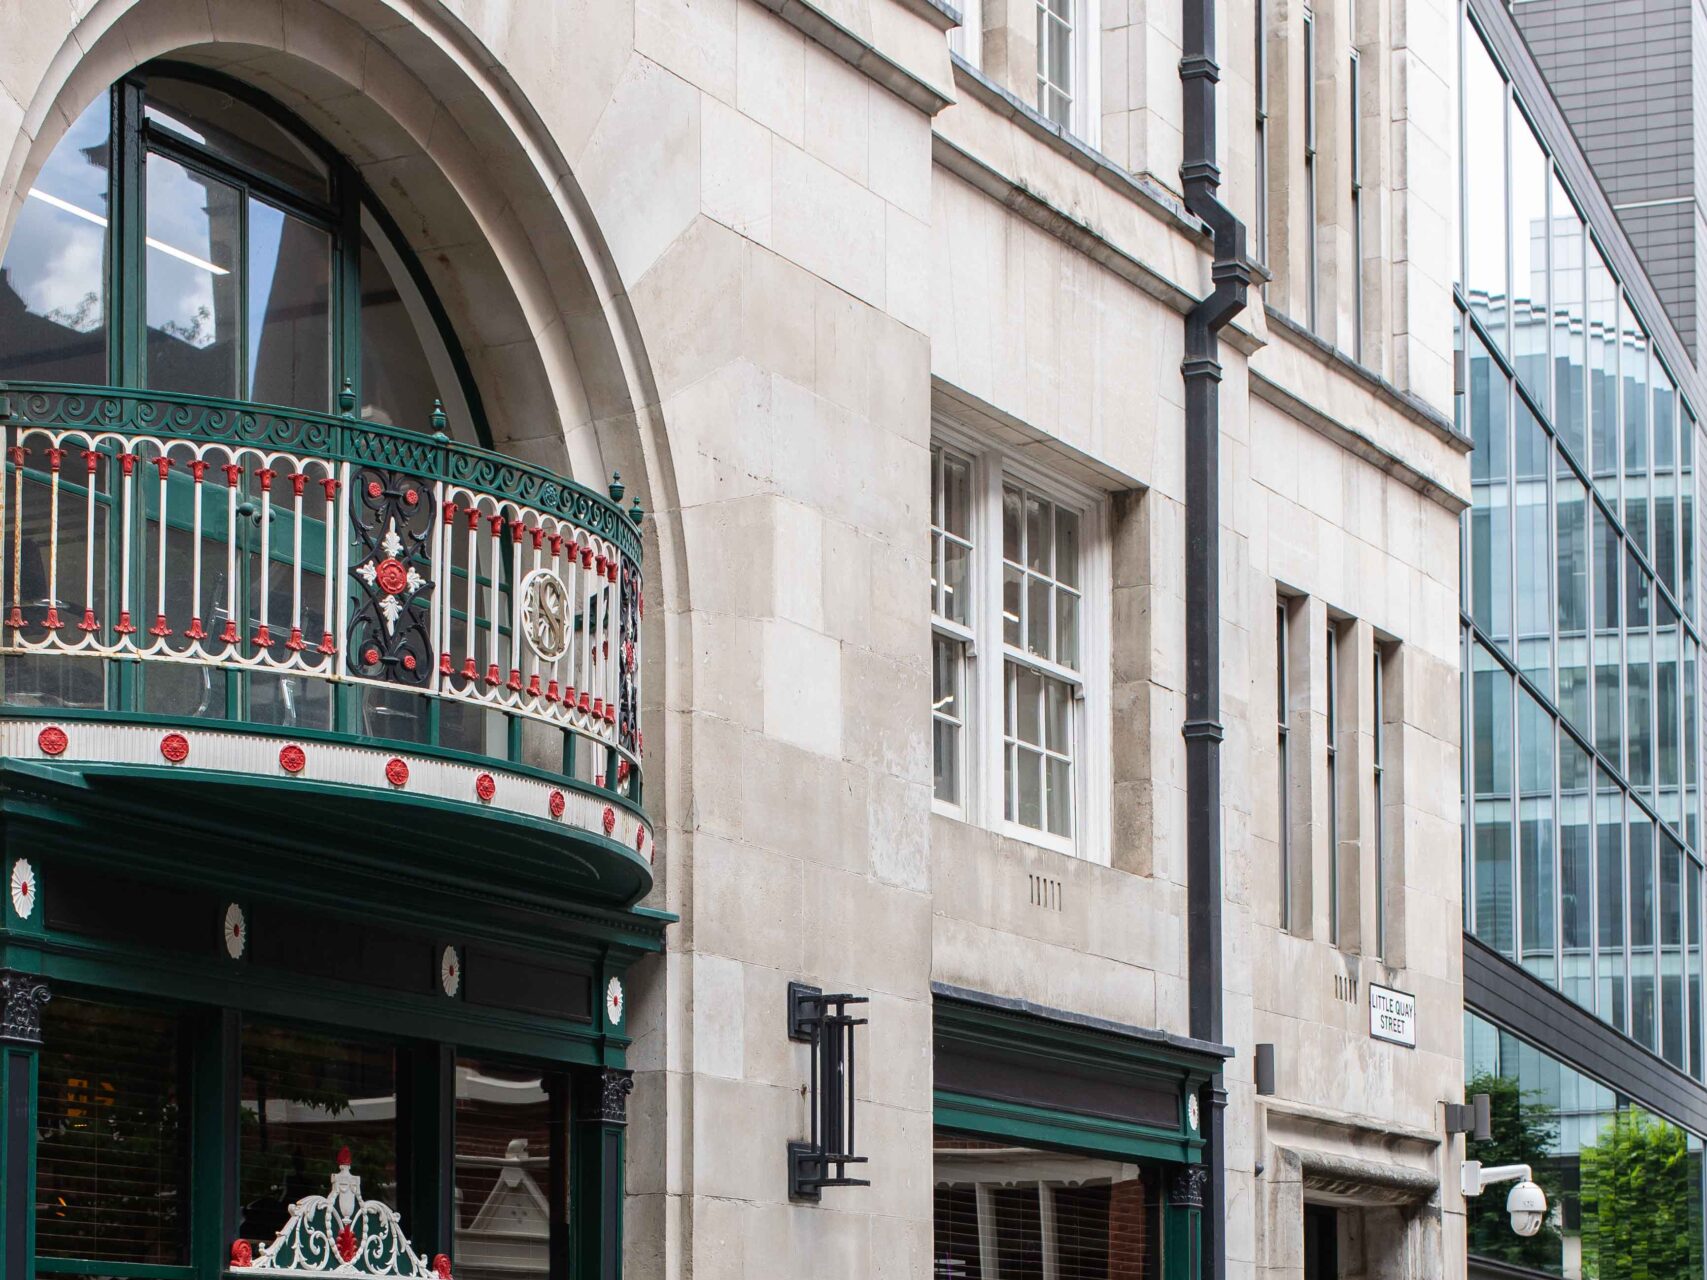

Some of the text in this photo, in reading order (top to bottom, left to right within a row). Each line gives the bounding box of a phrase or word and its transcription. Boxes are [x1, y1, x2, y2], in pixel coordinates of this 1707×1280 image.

[1372, 993, 1413, 1018] LITTLE QUAY
[1380, 1014, 1405, 1034] STREET
